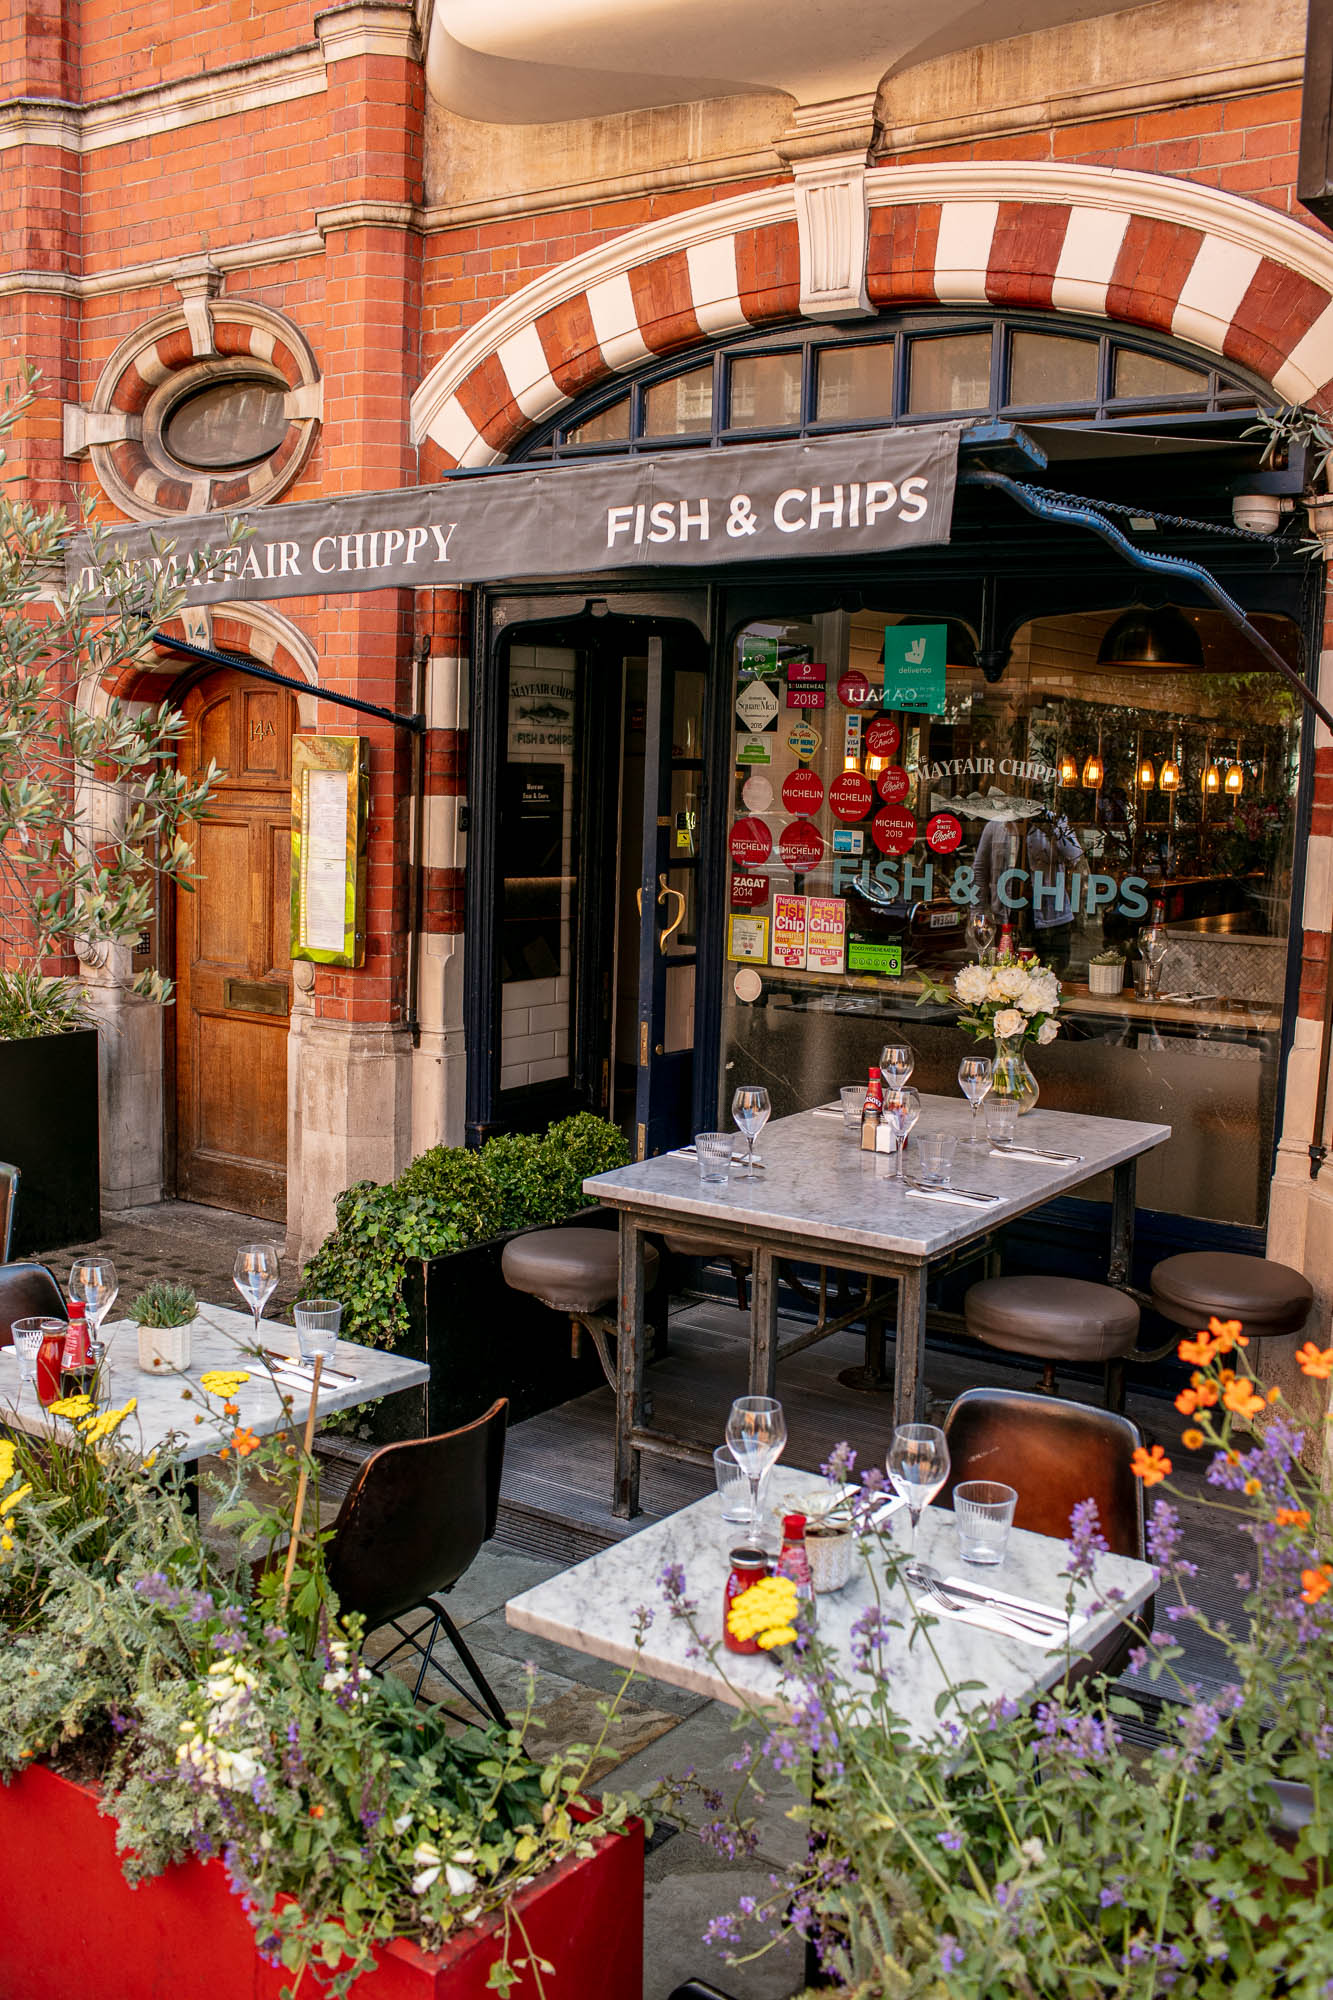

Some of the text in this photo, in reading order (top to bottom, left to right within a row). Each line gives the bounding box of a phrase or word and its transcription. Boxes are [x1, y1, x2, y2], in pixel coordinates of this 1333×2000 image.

[607, 476, 929, 548] FISH & CHIPS
[312, 523, 458, 574] CHIPPY
[188, 621, 207, 640] 14
[793, 693, 818, 705] 2018
[249, 719, 276, 742] 14A
[517, 732, 537, 744] FISH
[915, 758, 995, 783] MAYFAIR
[795, 773, 812, 781] 2017
[842, 778, 860, 787] 2018
[881, 780, 905, 795] Choice
[782, 789, 824, 799] MICHELIN
[829, 792, 872, 803] MICHELIN
[875, 819, 914, 829] MICHELIN
[885, 830, 903, 838] 2019
[931, 830, 957, 845] Choice
[731, 842, 769, 852] MICHELIN
[781, 846, 821, 856] MICHELIN
[733, 876, 766, 889] ZAGAT
[832, 858, 1149, 918] FISH & CHIPS
[732, 886, 753, 897] 2014
[777, 903, 805, 919] Fish
[811, 905, 844, 921] Fish
[776, 915, 805, 933] Chip
[810, 918, 843, 935] Chip
[777, 947, 802, 956] TOP 10
[811, 948, 840, 956] FINALIST
[890, 959, 897, 968] 5
